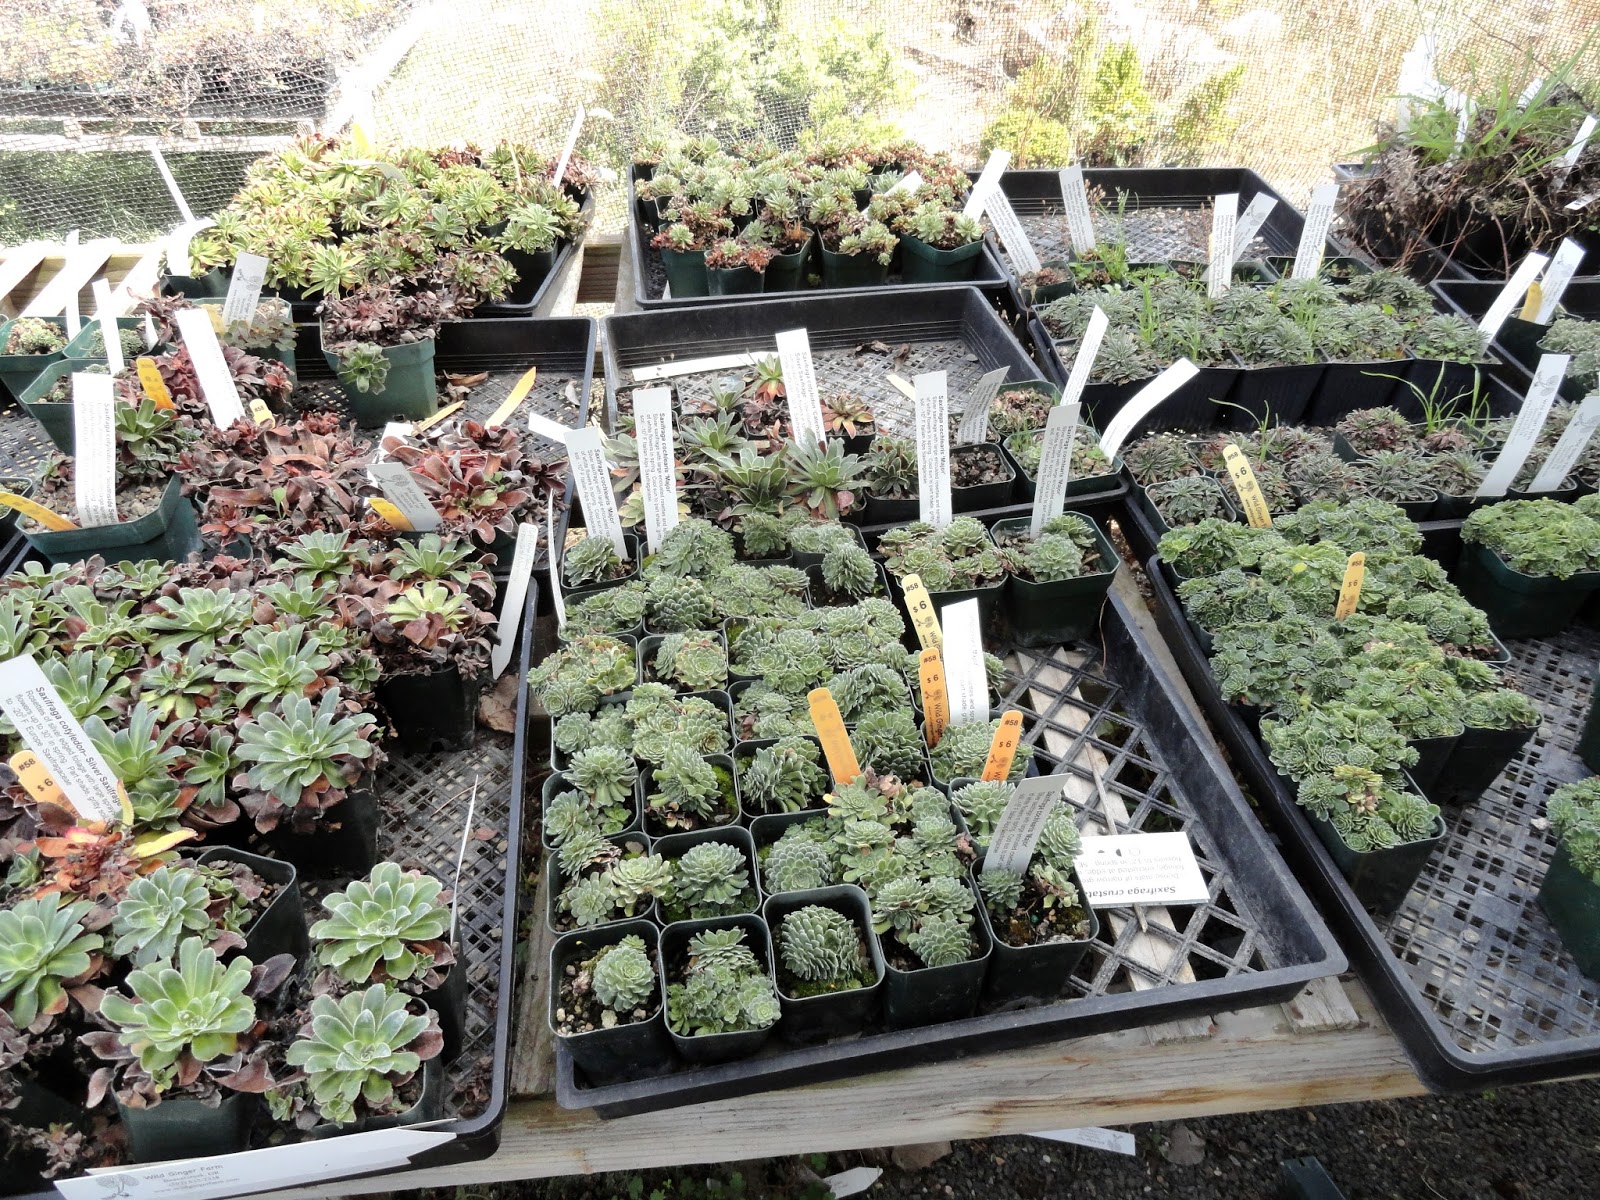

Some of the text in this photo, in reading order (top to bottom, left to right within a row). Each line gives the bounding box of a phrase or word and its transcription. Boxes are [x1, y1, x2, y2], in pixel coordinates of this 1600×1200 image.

[905, 582, 919, 592] #58
[919, 600, 927, 610] 6
[923, 654, 937, 664] #58
[933, 673, 939, 682] 6
[26, 726, 43, 746] Europe
[34, 687, 62, 719] Saxifraga
[86, 757, 102, 775] Silver
[26, 690, 45, 714] Rosettes
[49, 722, 61, 736] silver
[58, 738, 73, 755] edged
[71, 756, 86, 772] foliage
[85, 773, 94, 783] with
[92, 785, 104, 798] large
[1005, 740, 1012, 748] 6
[16, 694, 32, 713] flowers
[30, 715, 38, 723] up
[68, 766, 78, 777] Part
[88, 796, 100, 809] gritty
[18, 758, 36, 771] #58
[44, 778, 53, 786] 6
[1127, 885, 1175, 896] Saxifraga
[143, 1172, 165, 1180] Wild
[167, 1168, 196, 1177] Ginger
